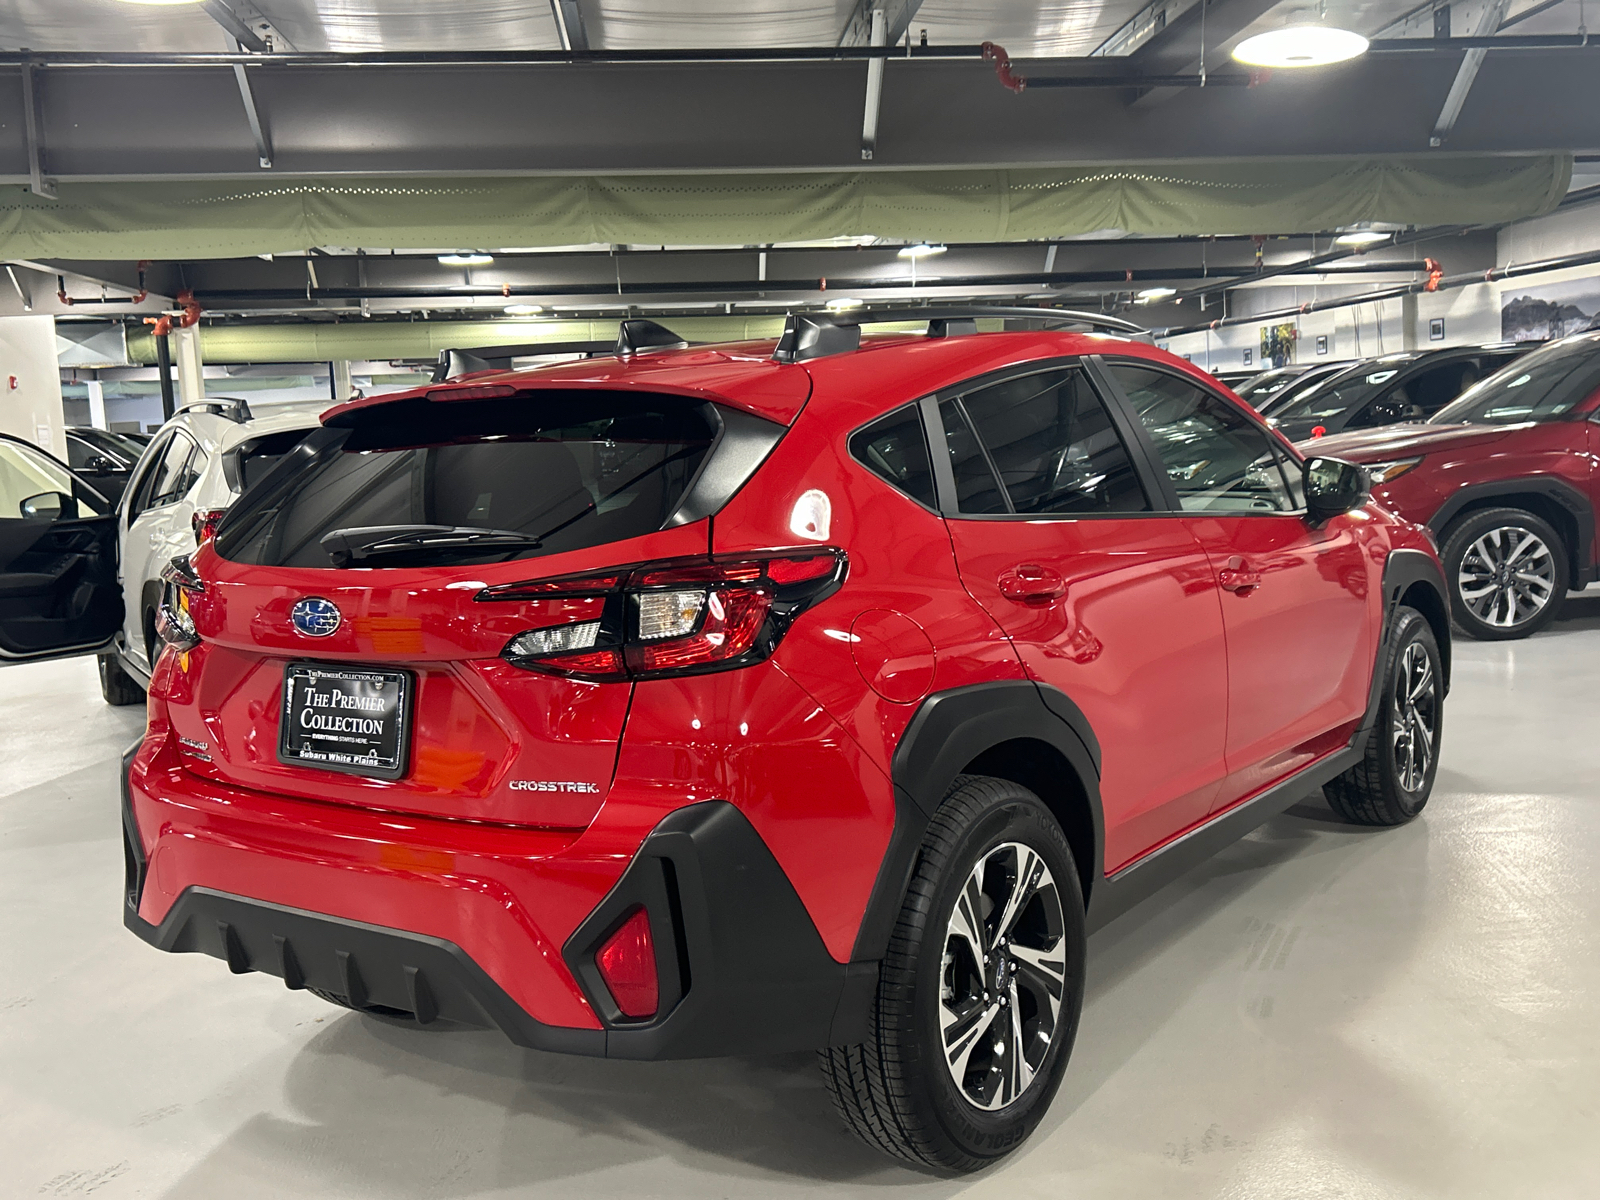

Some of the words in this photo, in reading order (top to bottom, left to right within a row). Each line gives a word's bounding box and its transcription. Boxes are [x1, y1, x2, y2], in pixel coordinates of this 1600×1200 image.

[304, 687, 330, 708] THE
[331, 689, 385, 712] PREMIER
[300, 708, 384, 735] COLLECTION
[312, 733, 338, 741] EVERYTHING
[300, 750, 326, 760] Subaru
[328, 753, 352, 762] White
[353, 756, 379, 766] Plains
